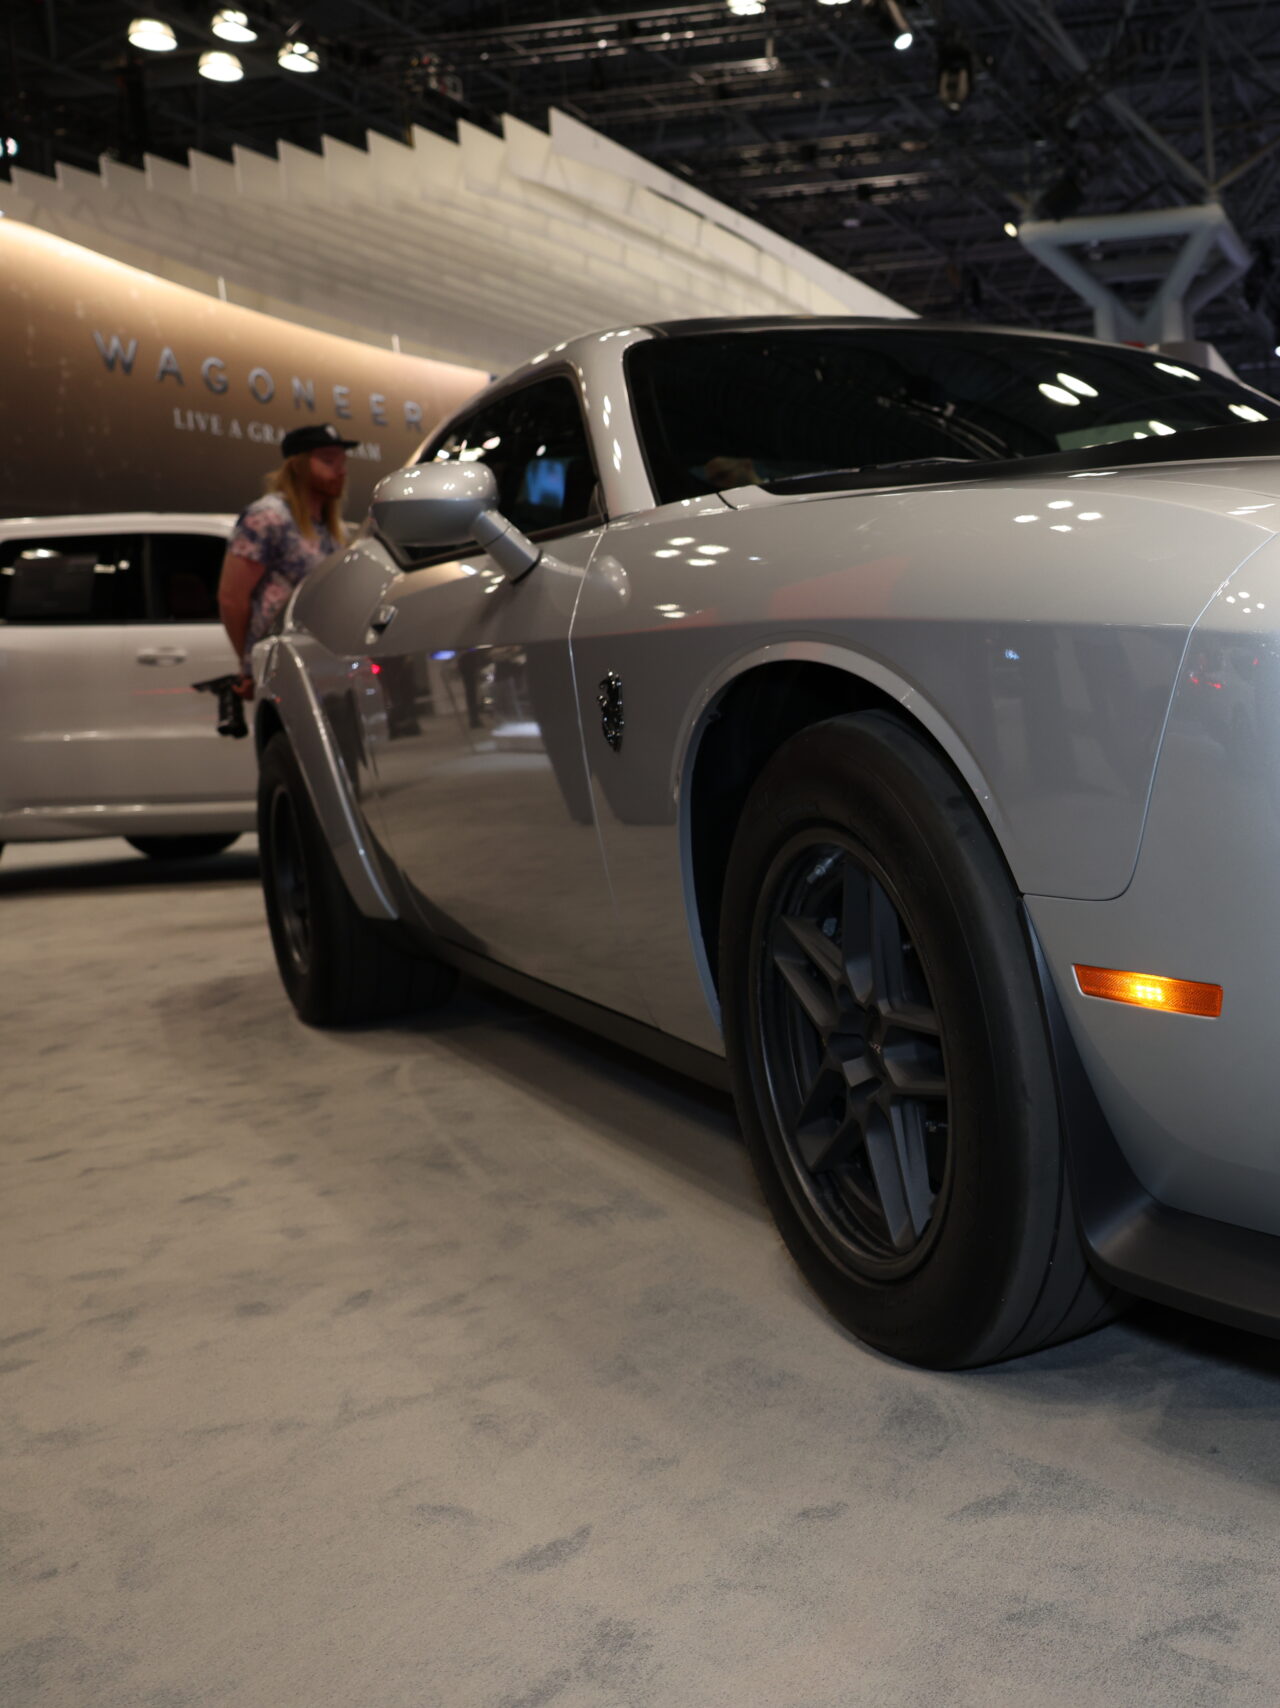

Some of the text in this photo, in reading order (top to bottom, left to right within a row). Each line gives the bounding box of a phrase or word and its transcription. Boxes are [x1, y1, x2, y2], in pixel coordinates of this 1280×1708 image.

[93, 331, 423, 433] WAGONEER
[173, 408, 224, 436] LIVE
[229, 419, 244, 440] A
